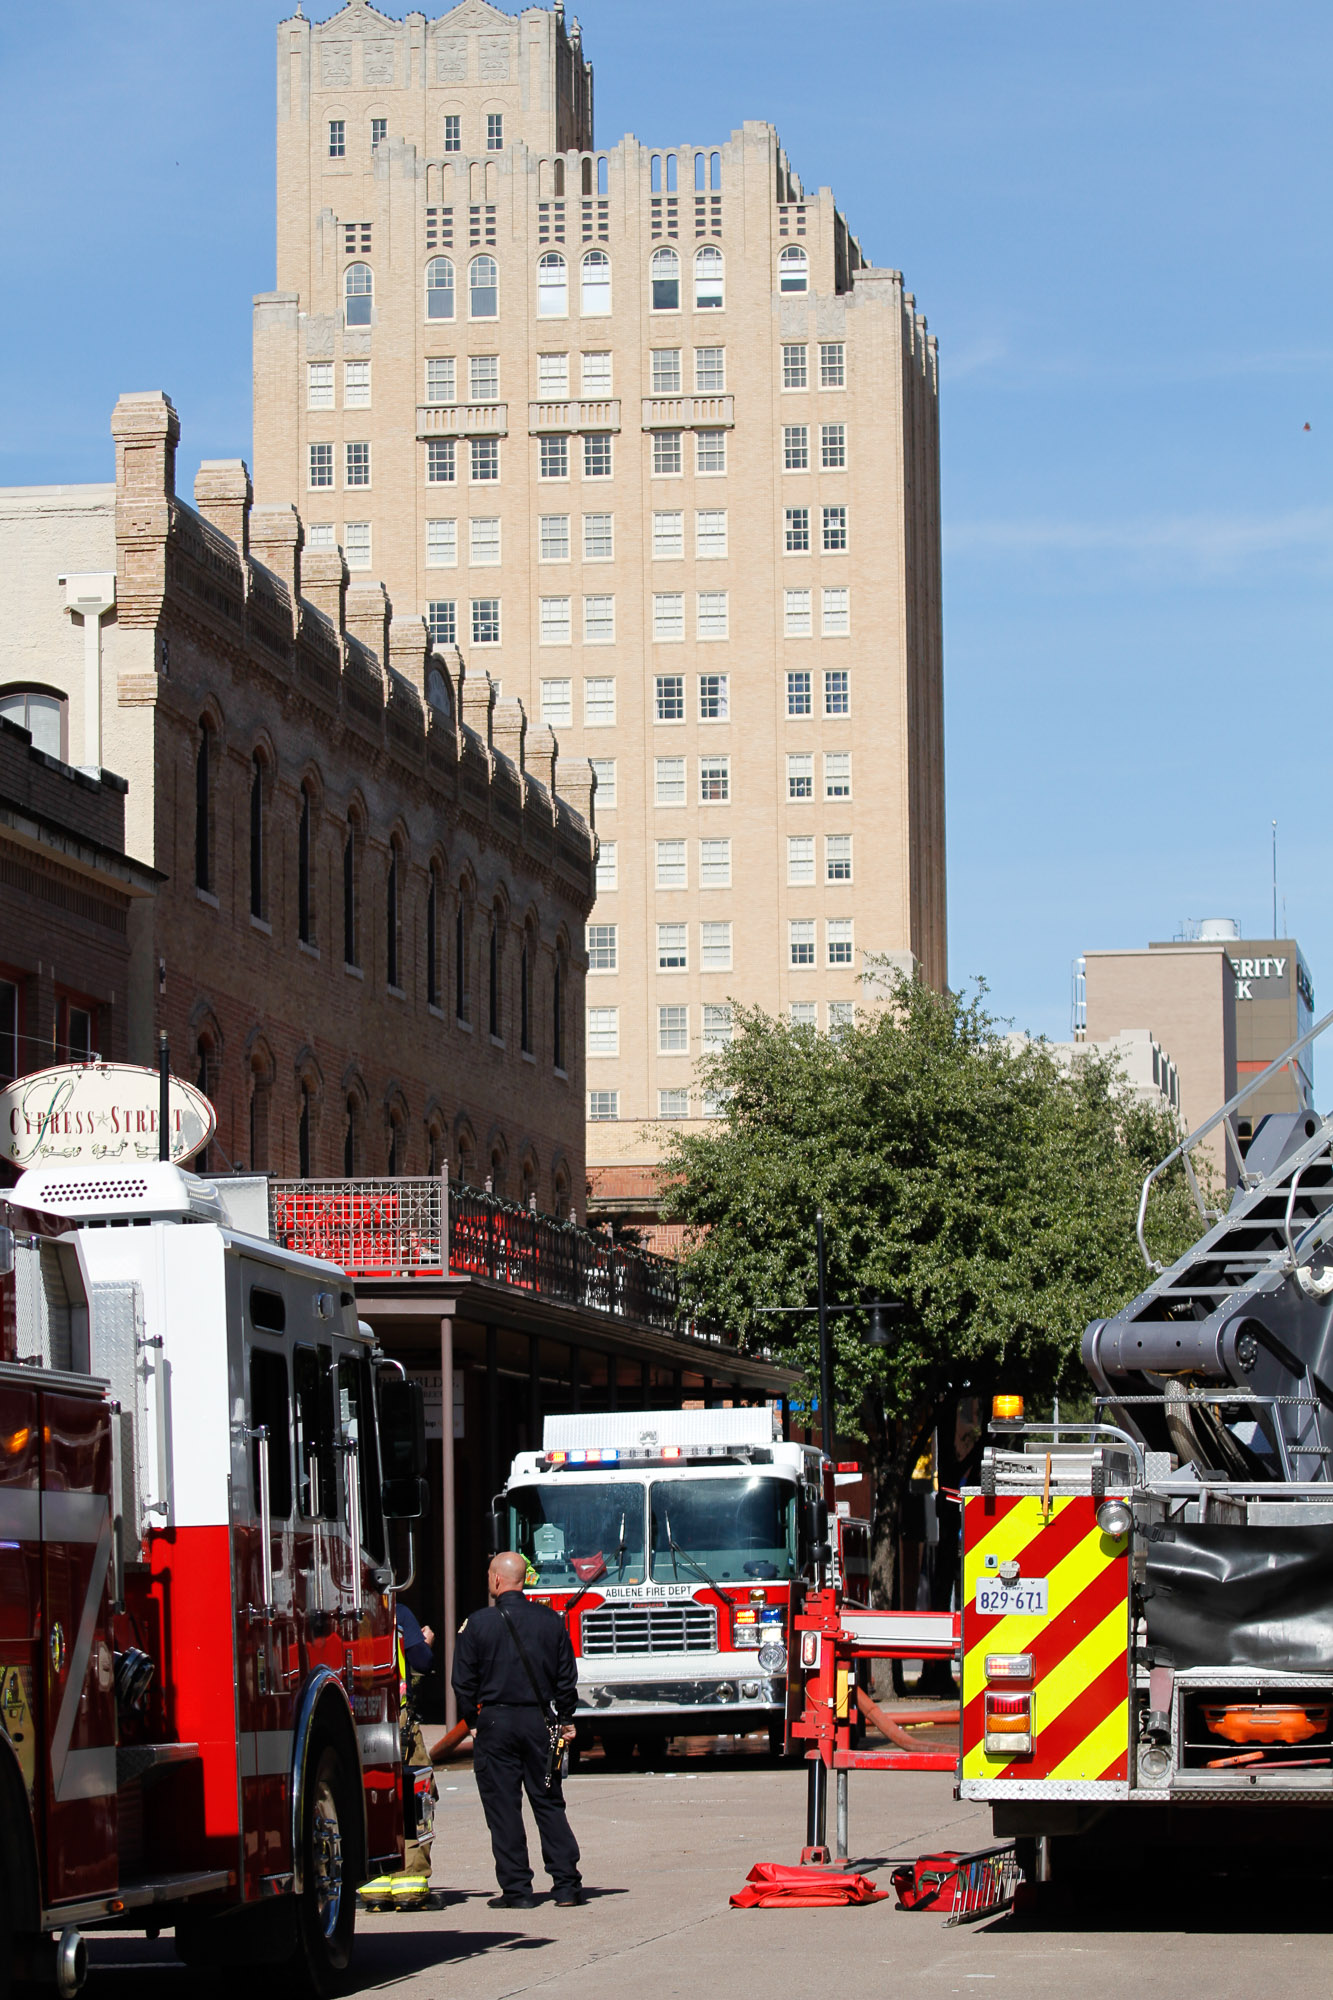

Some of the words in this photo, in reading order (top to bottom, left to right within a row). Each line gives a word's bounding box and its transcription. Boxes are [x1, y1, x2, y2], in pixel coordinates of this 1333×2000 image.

[9, 1107, 95, 1136] CYPRESS
[110, 1106, 183, 1134] STRET
[605, 1587, 643, 1598] ABILENE
[646, 1586, 666, 1597] FIRE
[668, 1585, 692, 1596] DEPT
